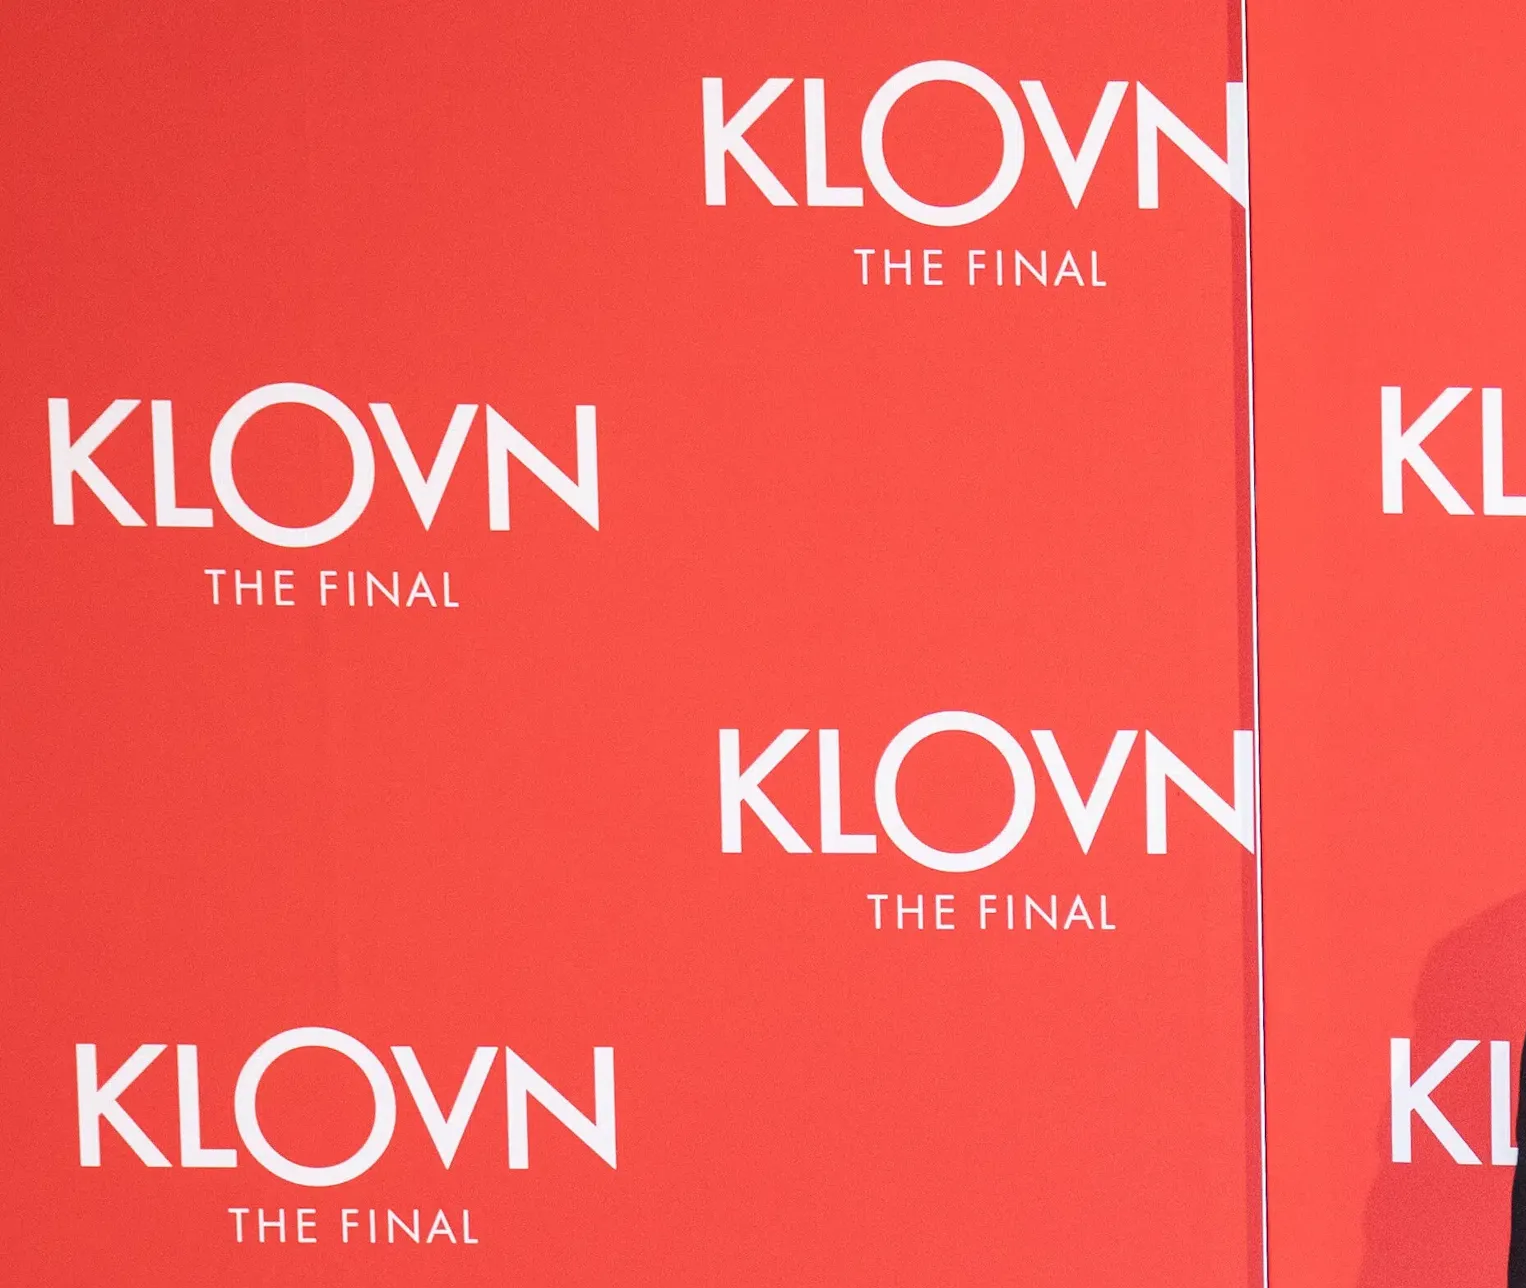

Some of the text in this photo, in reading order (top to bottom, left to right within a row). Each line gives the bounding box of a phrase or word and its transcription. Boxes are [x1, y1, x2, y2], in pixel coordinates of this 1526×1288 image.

[702, 59, 1247, 227] KLOVN
[854, 248, 1107, 288] THE FINAL
[48, 381, 599, 548] KLOVN
[204, 568, 460, 608] THE FINAL
[719, 710, 1255, 873] KLOVN
[867, 893, 1117, 931] THE FINAL
[76, 1026, 617, 1188] KLOVN
[228, 1207, 479, 1245] THE FINAL
